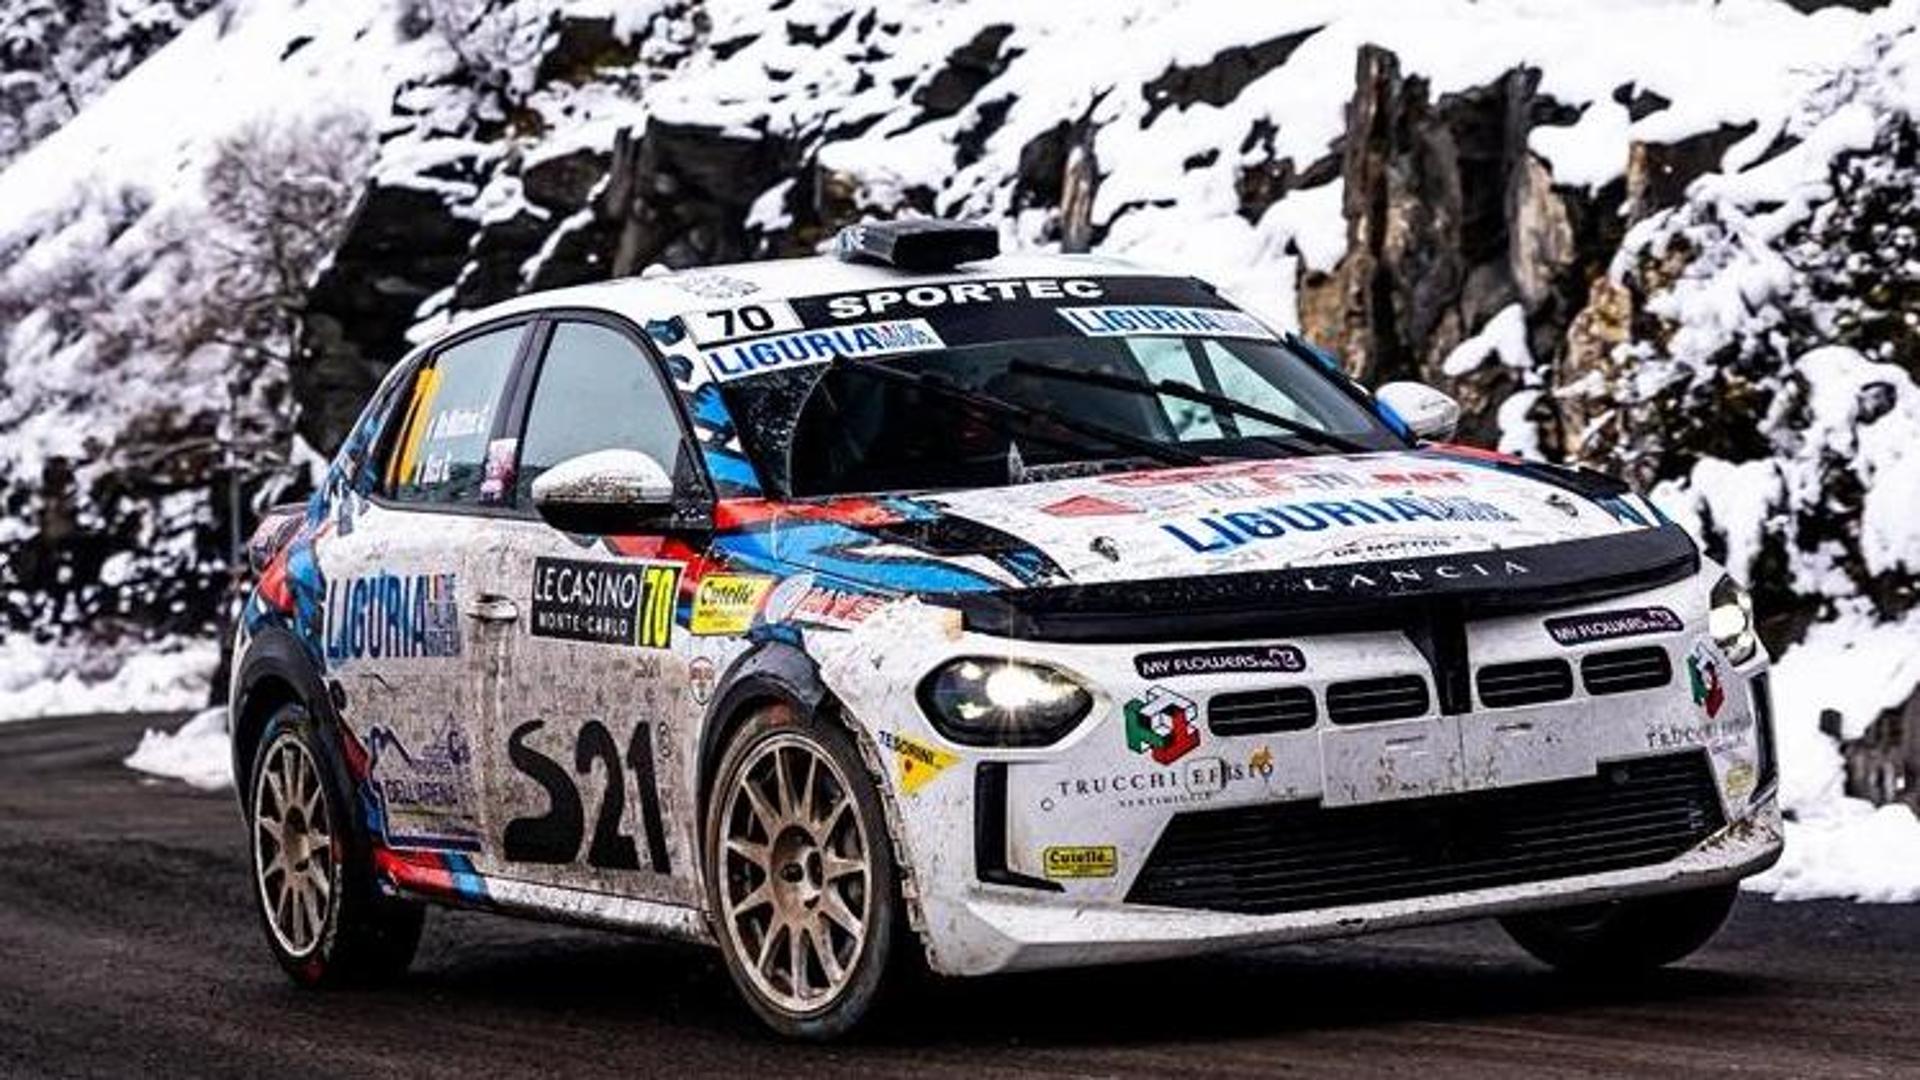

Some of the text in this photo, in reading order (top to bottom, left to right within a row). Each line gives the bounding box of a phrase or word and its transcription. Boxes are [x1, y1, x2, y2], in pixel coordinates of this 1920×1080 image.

[828, 280, 1103, 319] SPORTEC
[707, 305, 774, 336] 70
[1069, 307, 1222, 333] LIGURIA
[709, 327, 880, 375] LIGURIA
[1160, 498, 1441, 554] LIGURIA
[1302, 560, 1529, 592] LANCIA
[326, 575, 427, 657] LIGURIA
[643, 568, 675, 648] 70
[1143, 661, 1170, 675] MY
[1174, 655, 1258, 671] FLOWERS
[504, 719, 671, 875] S21
[1057, 771, 1177, 796] TRUCCHI
